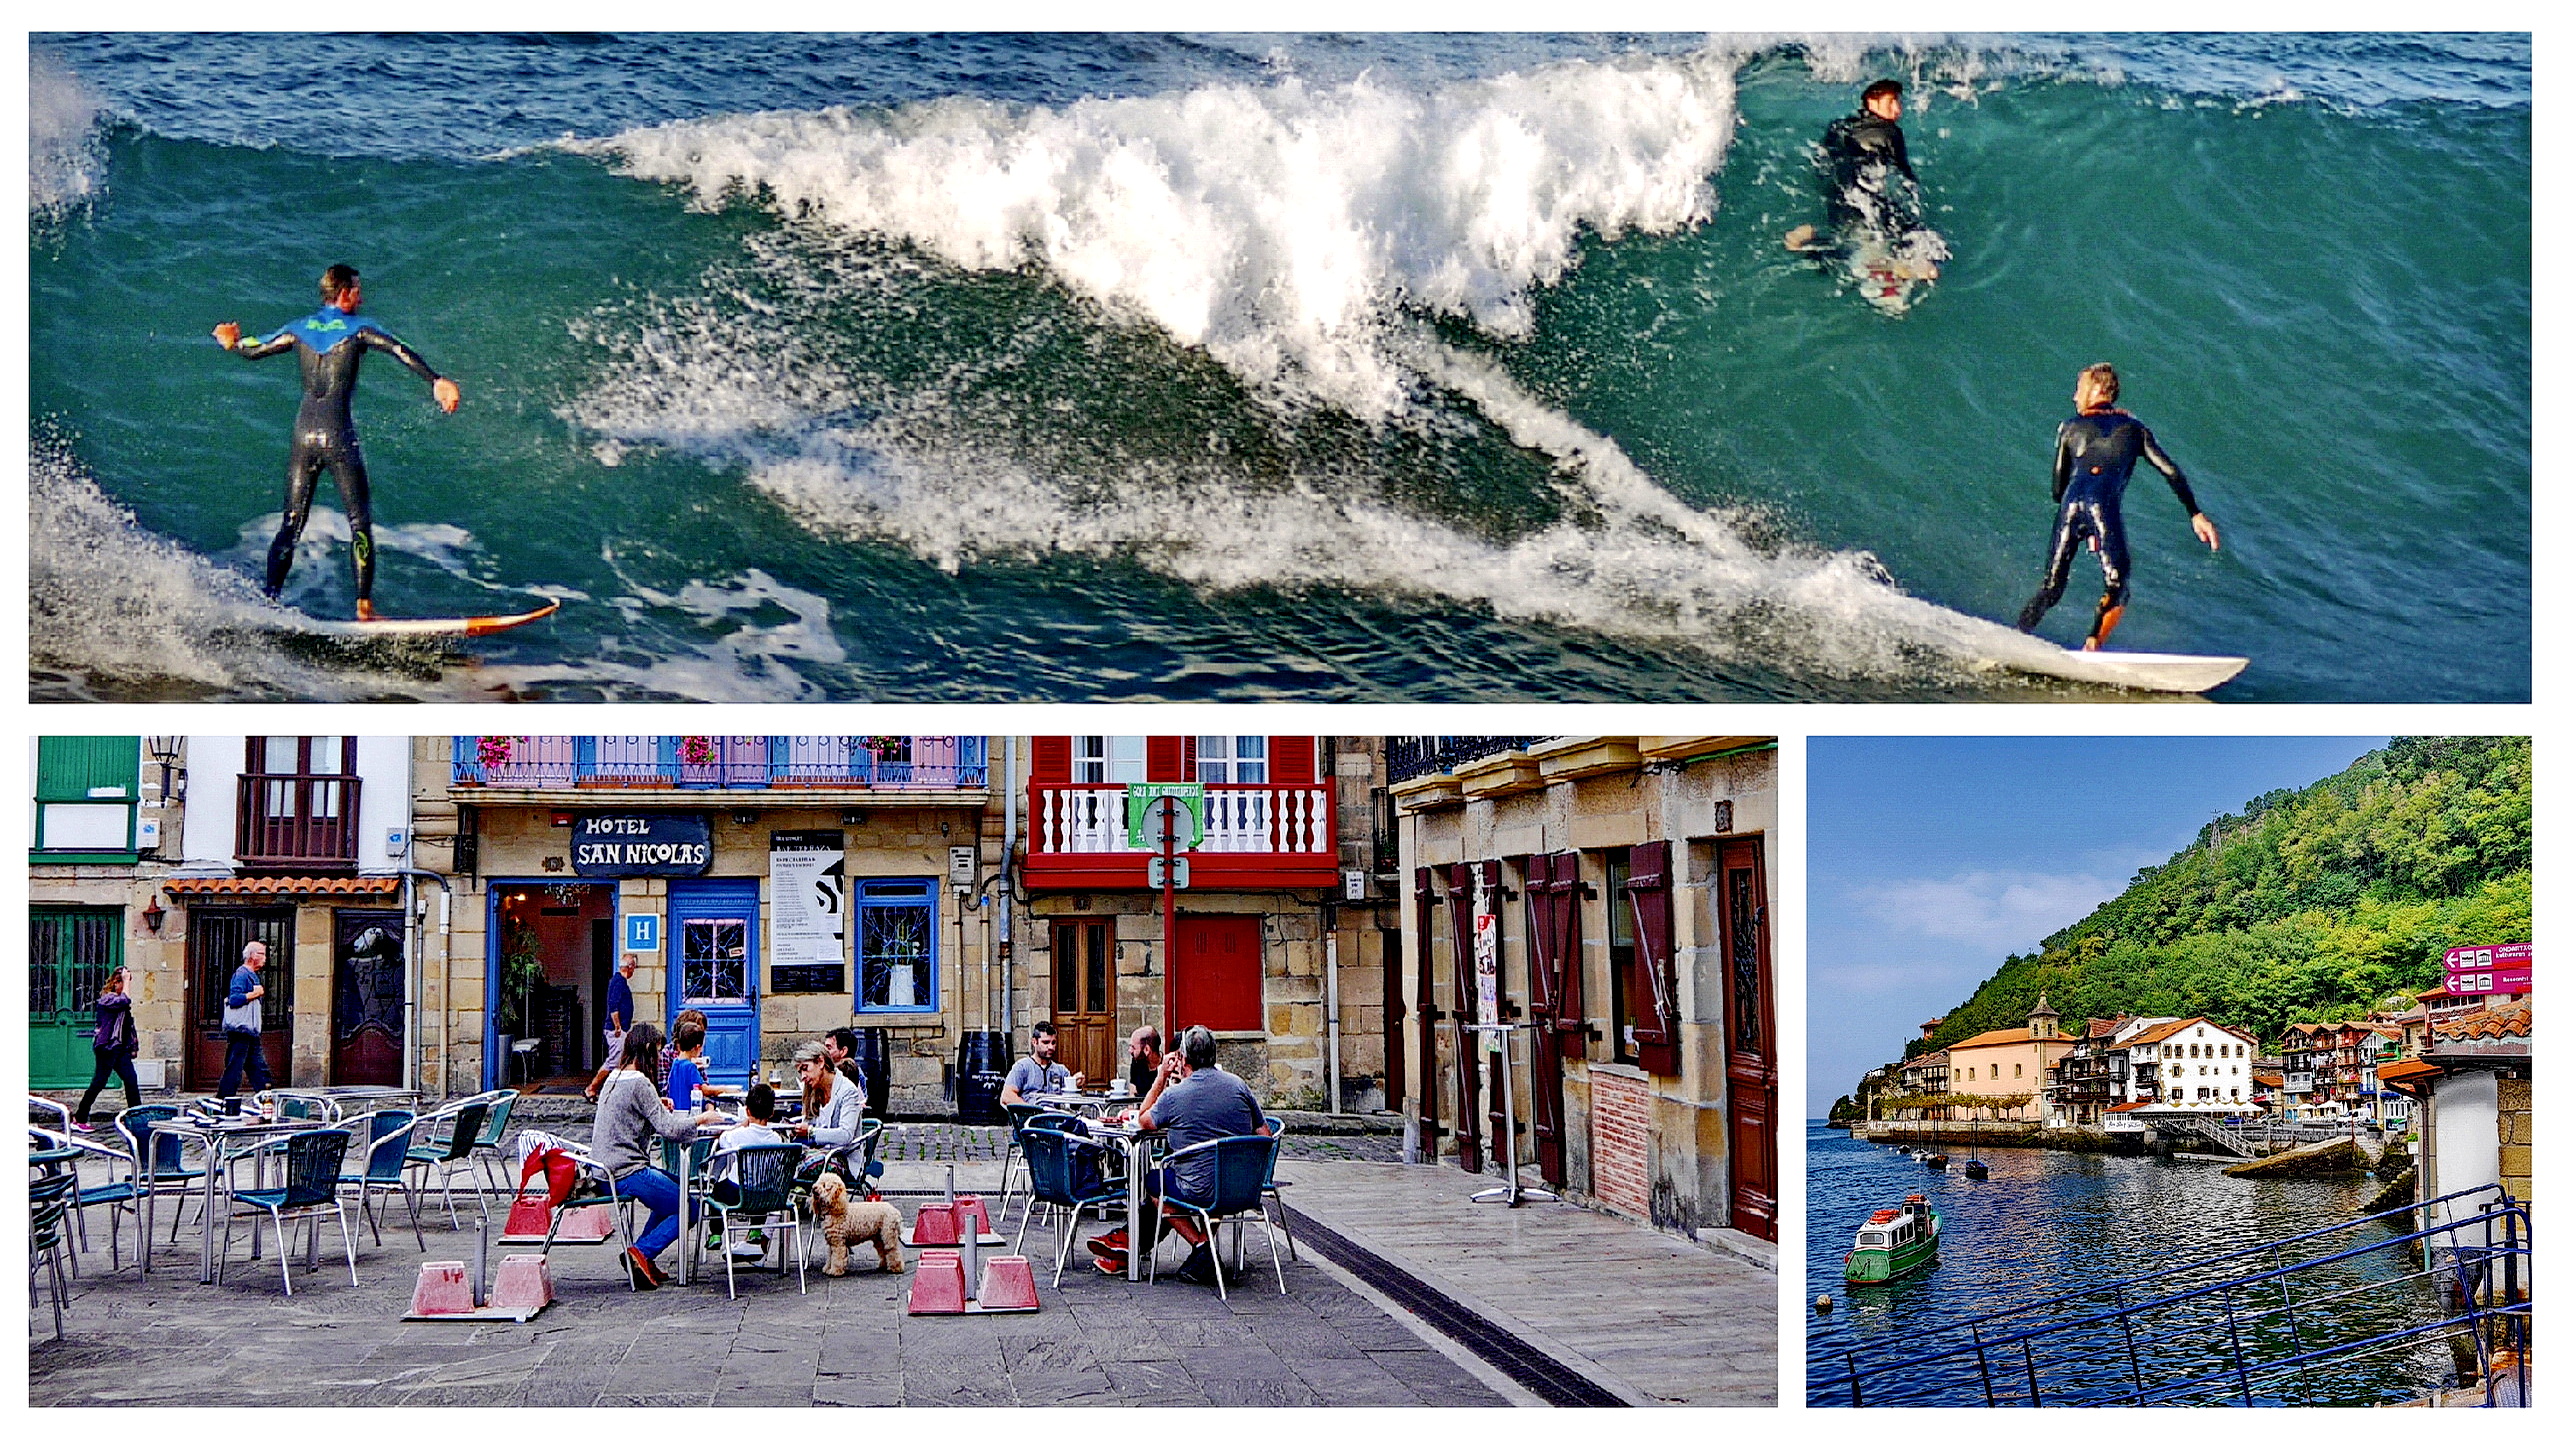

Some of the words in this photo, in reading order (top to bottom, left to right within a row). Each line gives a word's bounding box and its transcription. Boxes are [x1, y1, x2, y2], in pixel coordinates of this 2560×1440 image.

[586, 818, 651, 835] HOTEL
[577, 843, 621, 865] SAN
[635, 921, 651, 940] H
